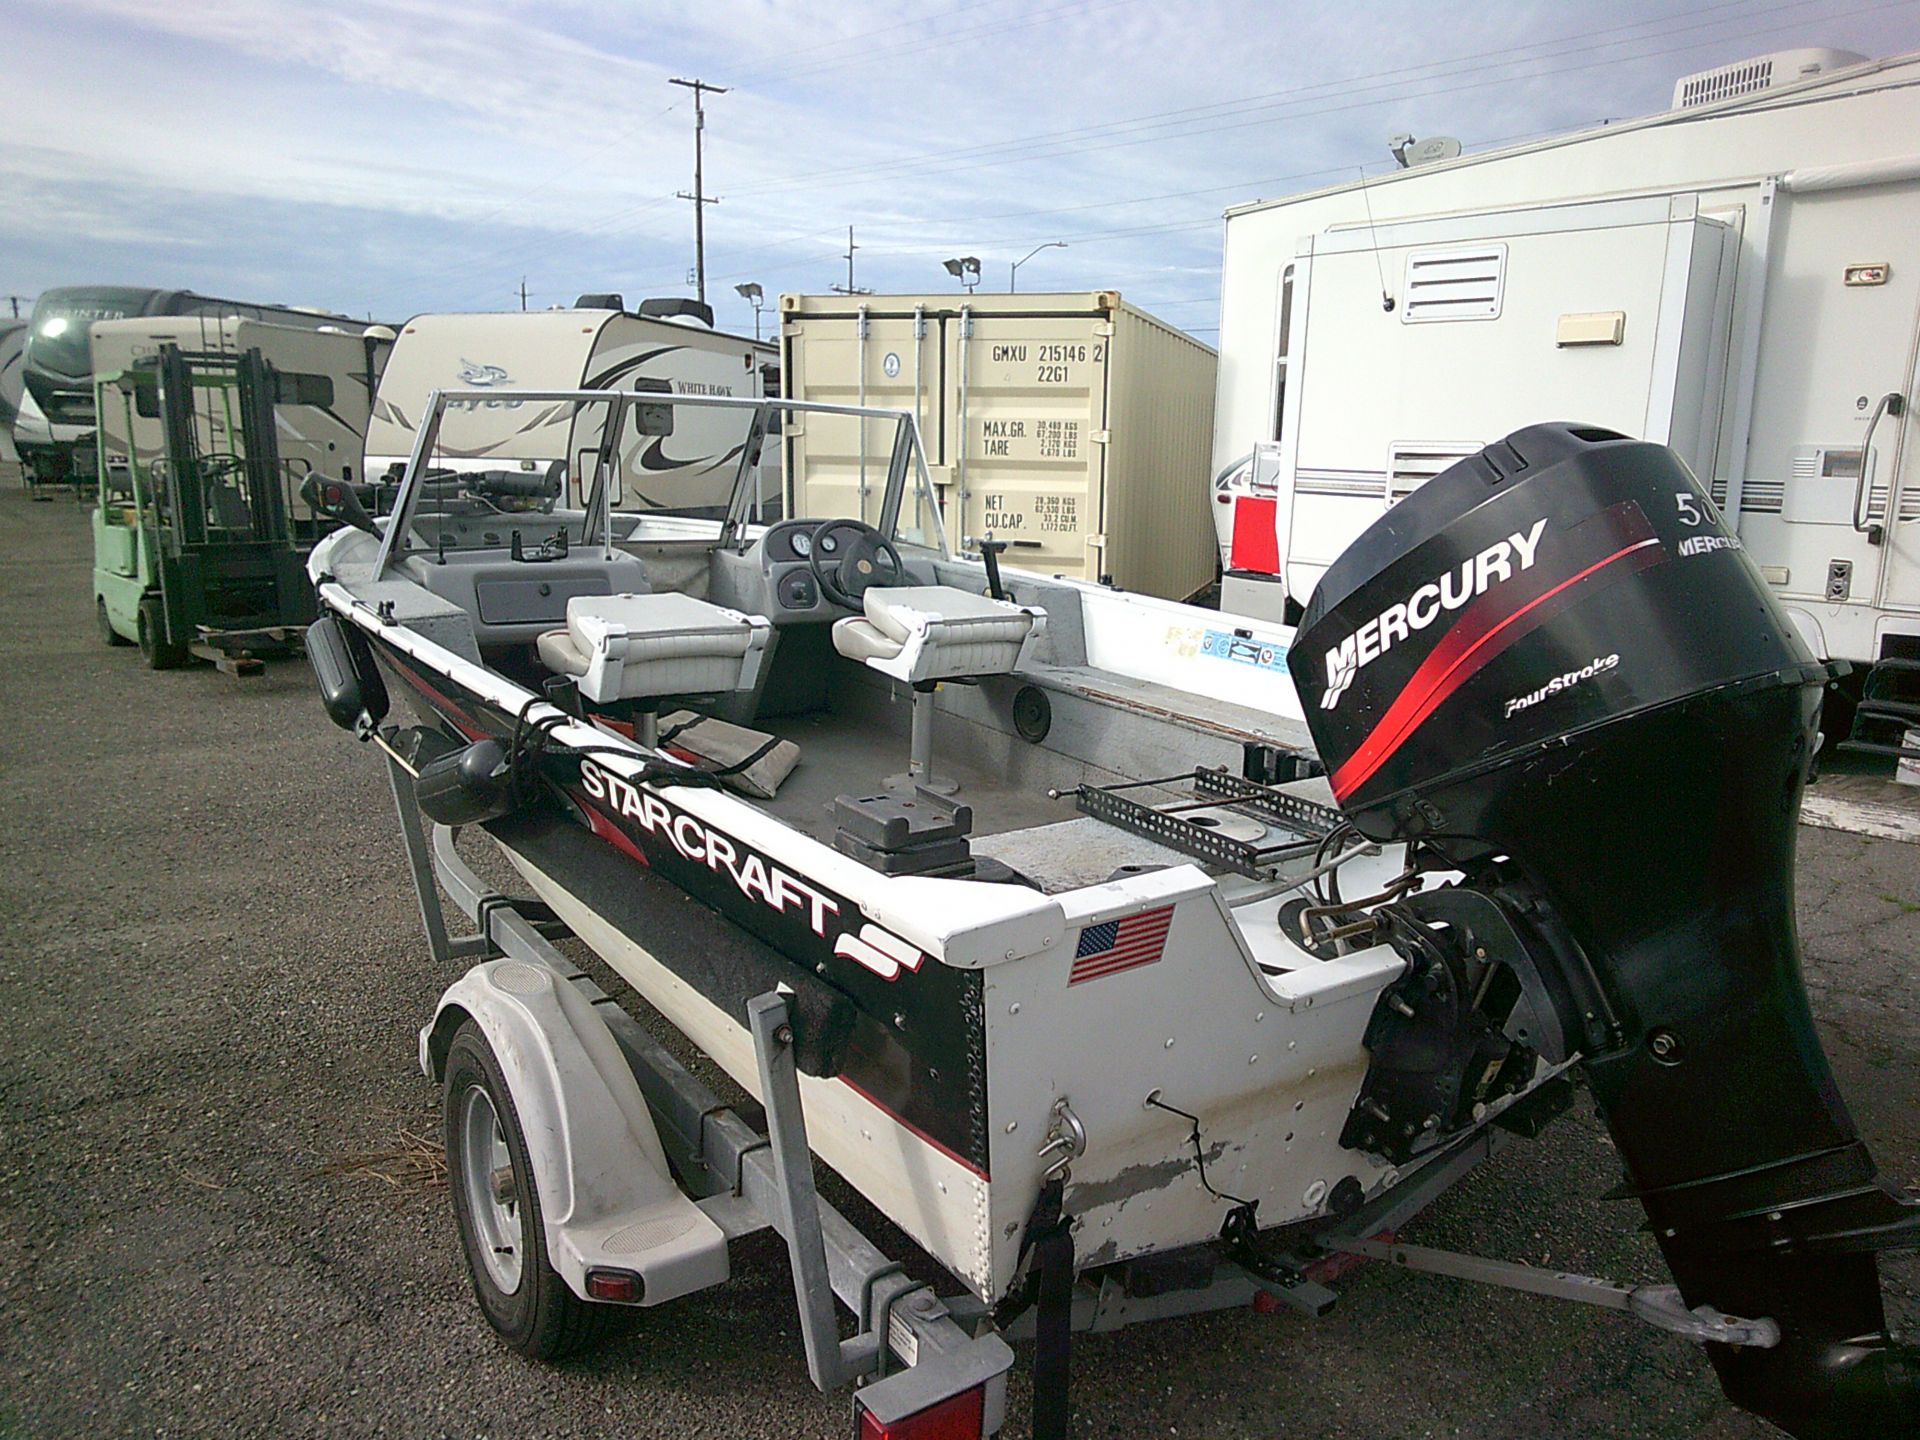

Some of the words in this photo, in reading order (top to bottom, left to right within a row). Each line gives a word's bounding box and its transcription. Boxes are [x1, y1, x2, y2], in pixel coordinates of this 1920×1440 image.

[993, 345, 1027, 362] GMXU
[1039, 345, 1086, 362] 215146
[1093, 344, 1103, 362] 2
[1038, 366, 1068, 382] 22G1
[678, 381, 707, 395] WHITE
[983, 421, 1027, 438] MAX.GR.
[1064, 431, 1078, 440] LBS
[984, 440, 1009, 456] TARE
[1063, 449, 1076, 458] LBS
[985, 495, 1003, 510] NET
[1062, 506, 1075, 515] LBS
[1675, 493, 1717, 526] 50
[985, 513, 1027, 529] CU.CAP.
[1320, 518, 1548, 710] MERCURY
[1505, 654, 1619, 719] FourStroke
[581, 759, 840, 937] STARCRAFT
